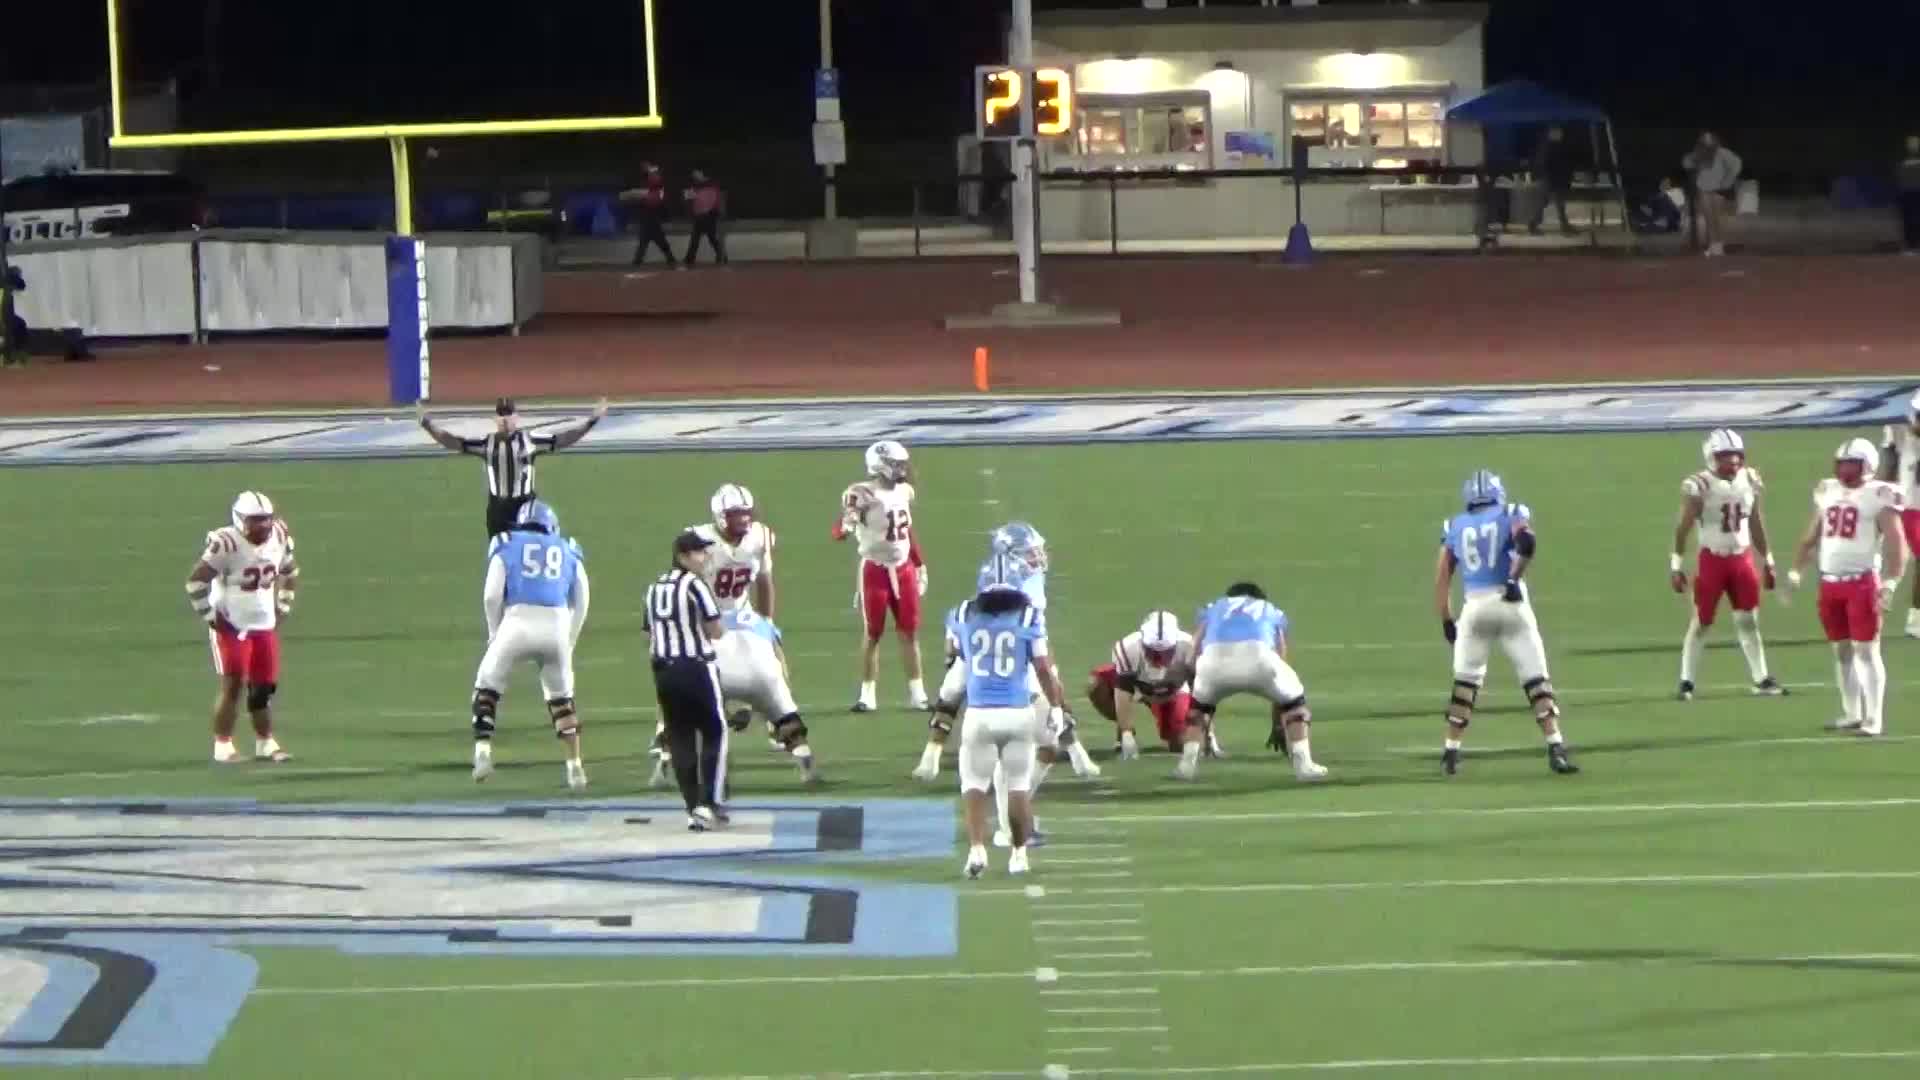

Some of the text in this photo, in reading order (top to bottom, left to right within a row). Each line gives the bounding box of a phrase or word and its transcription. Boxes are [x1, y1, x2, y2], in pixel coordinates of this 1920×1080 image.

[986, 69, 1071, 133] 23
[9, 221, 110, 241] OLICE
[886, 509, 909, 542] 12
[1826, 505, 1858, 539] 98
[521, 543, 562, 580] 58
[1462, 521, 1498, 571] 67
[971, 629, 1016, 677] 26
